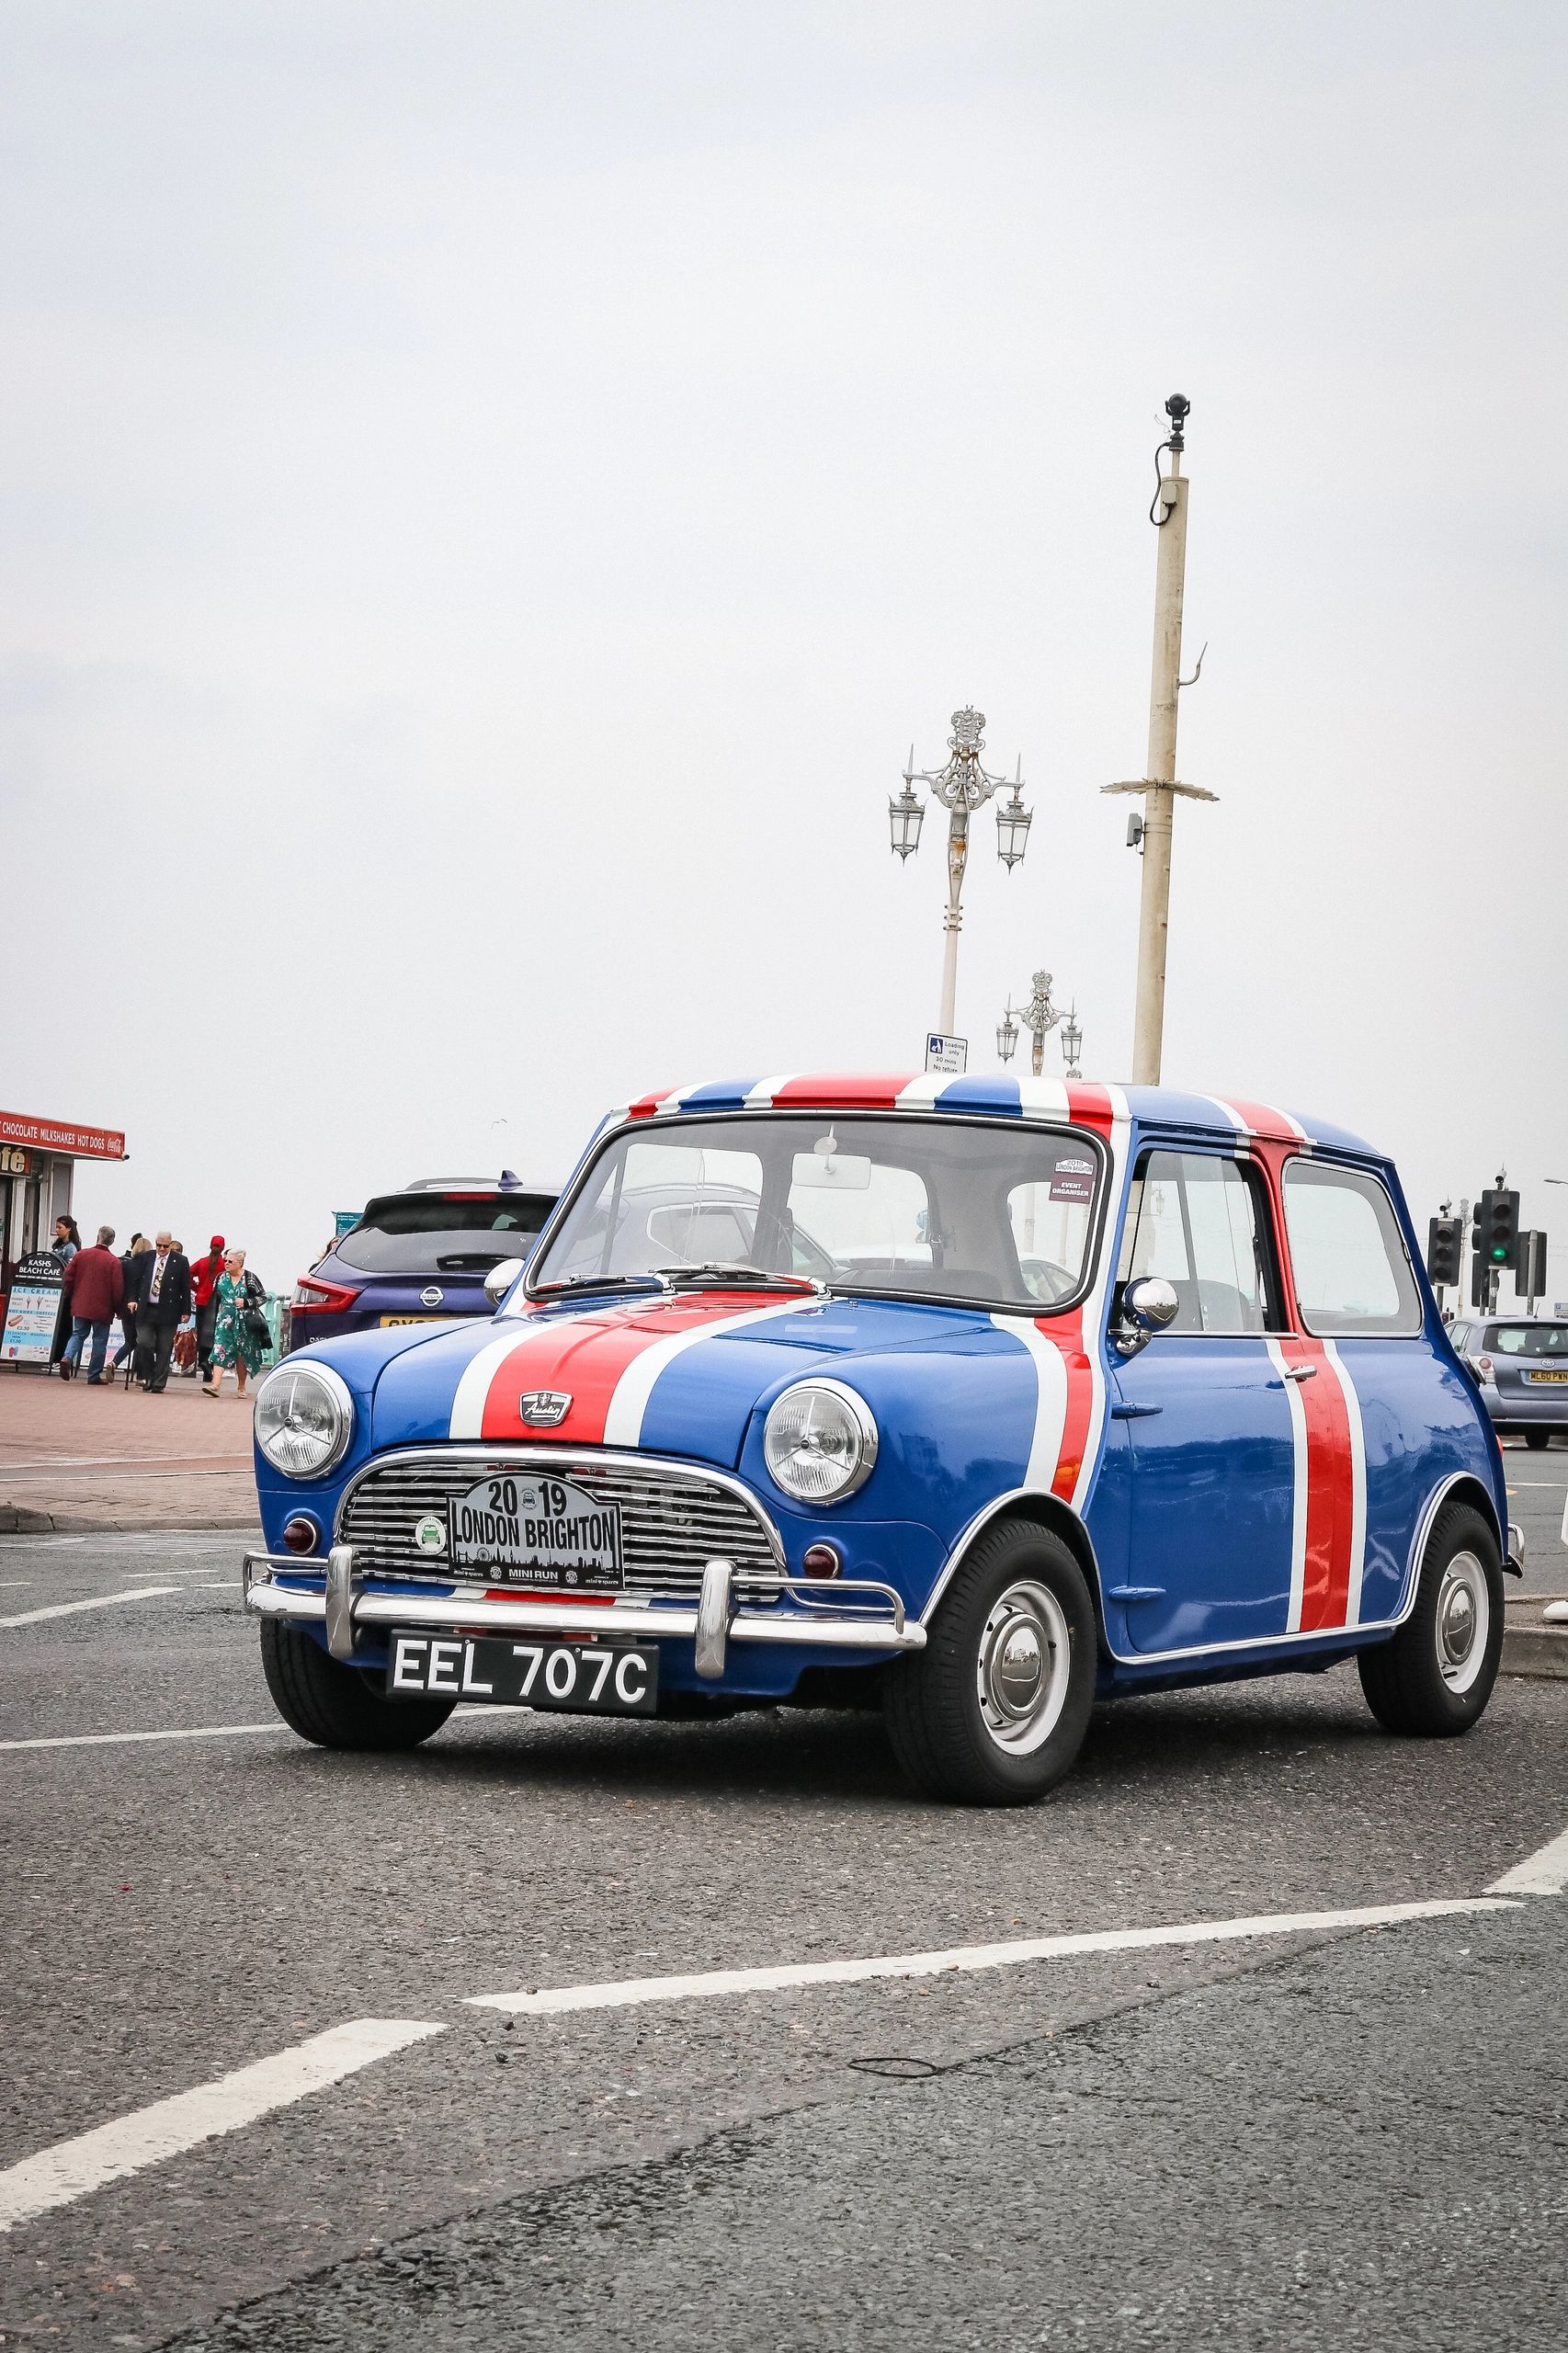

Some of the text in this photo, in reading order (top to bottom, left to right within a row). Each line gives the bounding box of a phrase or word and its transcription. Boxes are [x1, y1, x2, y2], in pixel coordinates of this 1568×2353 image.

[945, 1041, 964, 1050] Loading
[2, 1120, 38, 1139] CHOCOLATE
[40, 1128, 75, 1145] MILKSHAKES
[77, 1134, 89, 1147] HOT
[89, 1136, 105, 1150] DOGS
[18, 1266, 61, 1276] BEACH CAFÉ
[524, 1402, 561, 1418] Austin
[488, 1479, 518, 1517] 20
[539, 1481, 567, 1518] 19
[451, 1499, 520, 1548] LONDON
[525, 1508, 615, 1552] BRIGHTON
[508, 1568, 533, 1578] MINI
[534, 1570, 559, 1580] RUN
[393, 1639, 647, 1704] EEL 707C
